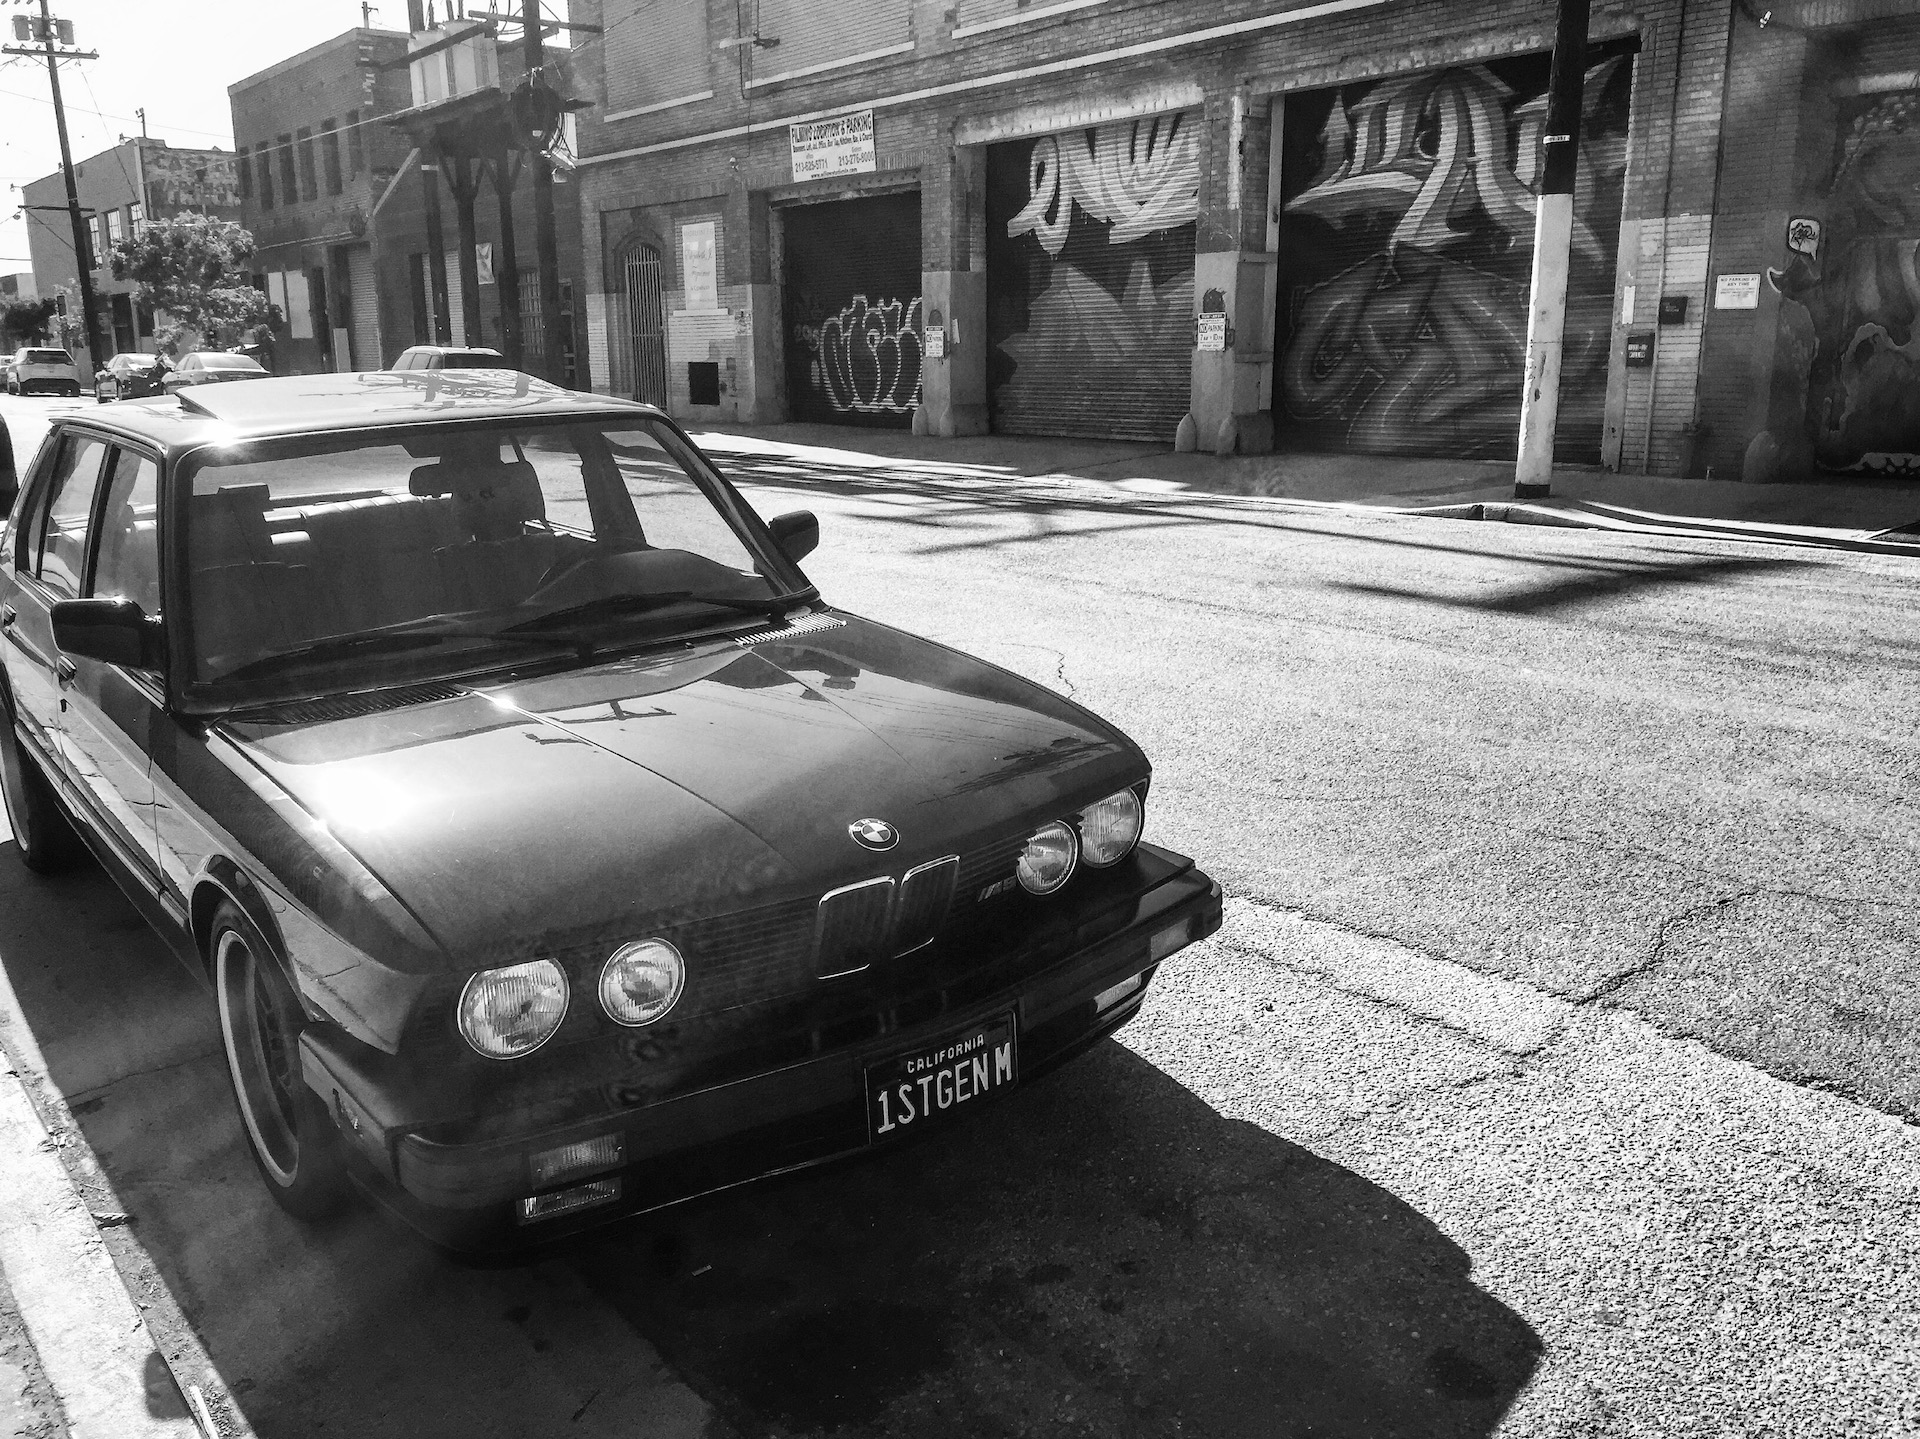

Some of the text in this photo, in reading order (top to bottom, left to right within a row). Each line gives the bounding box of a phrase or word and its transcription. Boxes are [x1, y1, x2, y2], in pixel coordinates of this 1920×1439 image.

[907, 1033, 985, 1074] CALIFORNIA
[877, 1042, 1013, 1134] 1STGEN M
